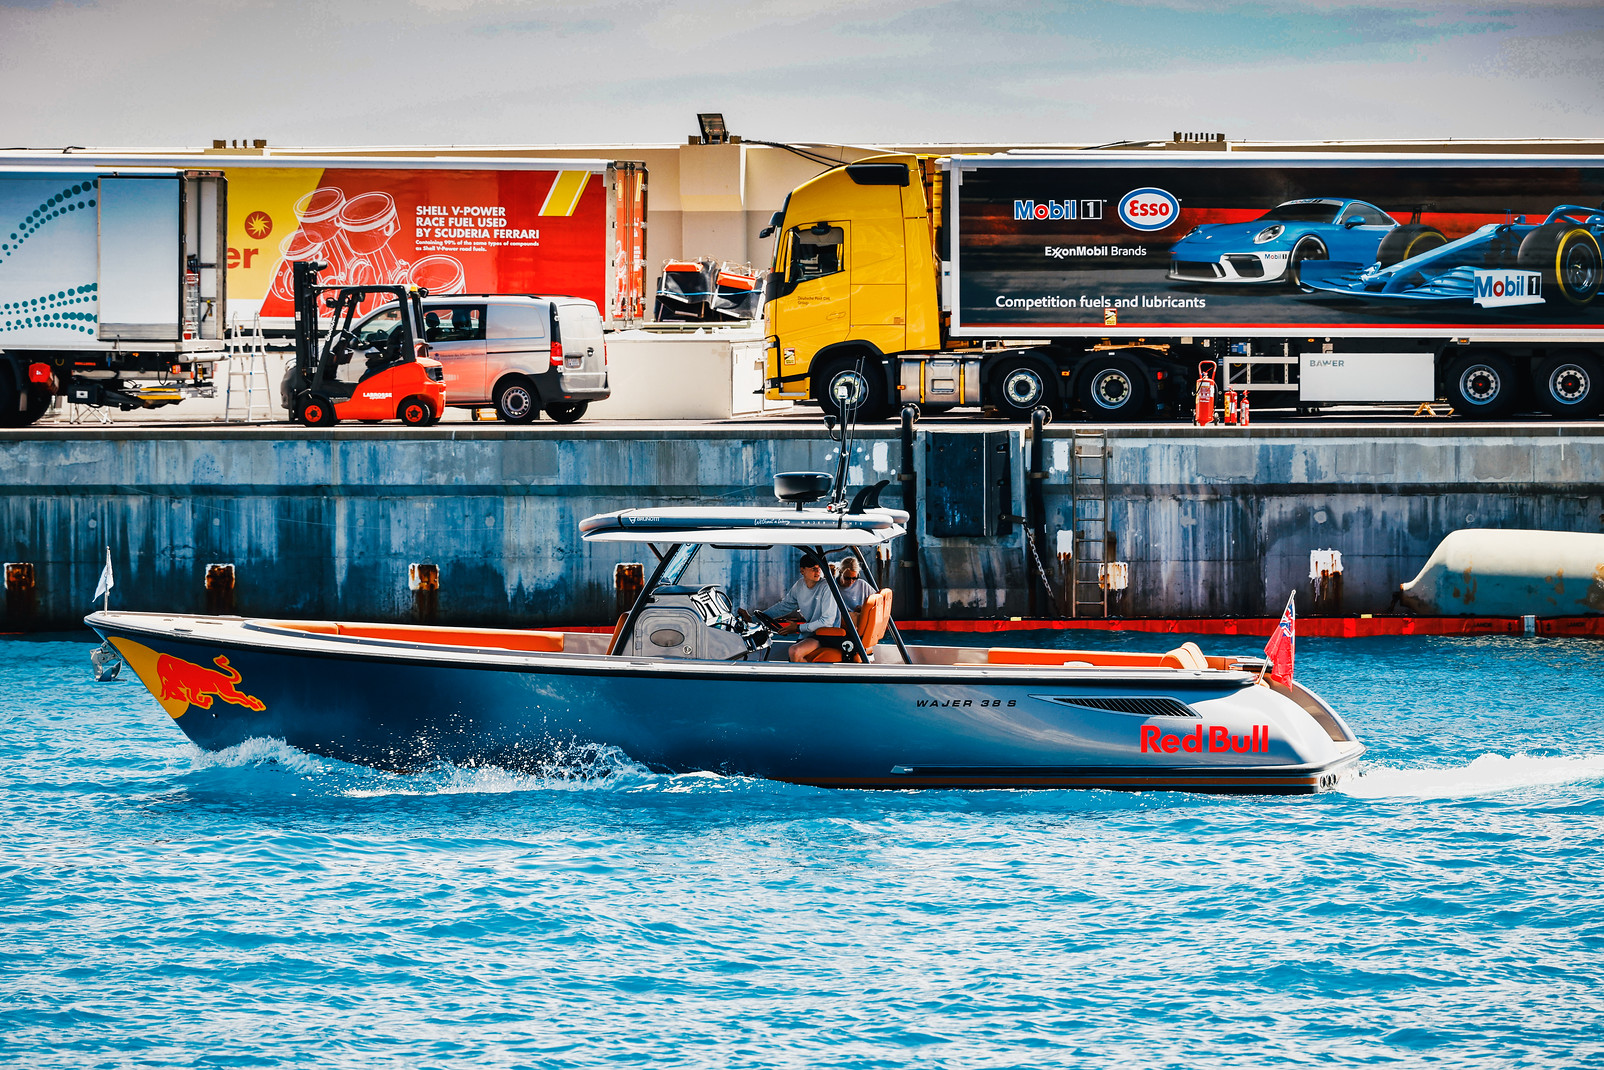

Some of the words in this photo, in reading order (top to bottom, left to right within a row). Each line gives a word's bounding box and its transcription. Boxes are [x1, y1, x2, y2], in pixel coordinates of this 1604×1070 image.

[416, 205, 448, 216] SHELL
[452, 206, 506, 217] V-POWER
[1014, 200, 1077, 220] Mobil
[1129, 199, 1170, 217] Esso
[416, 217, 445, 227] RACE
[448, 217, 475, 228] FUEL
[477, 218, 507, 228] USED
[416, 228, 431, 238] BY
[434, 228, 490, 239] SCUDERIA
[493, 229, 540, 240] FERRARI
[1045, 246, 1108, 259] ExxonMobil
[1111, 246, 1147, 257] Brands
[1474, 275, 1525, 298] Mobil
[995, 296, 1076, 310] Competition
[1080, 296, 1111, 308] fuels
[1114, 296, 1139, 308] and
[1142, 296, 1206, 308] lubricants
[1309, 359, 1345, 367] BAWER
[916, 699, 973, 708] WAJER
[980, 699, 1002, 708] 38
[1007, 699, 1017, 708] S
[1140, 724, 1203, 753] Red
[1208, 724, 1269, 754] Bull
